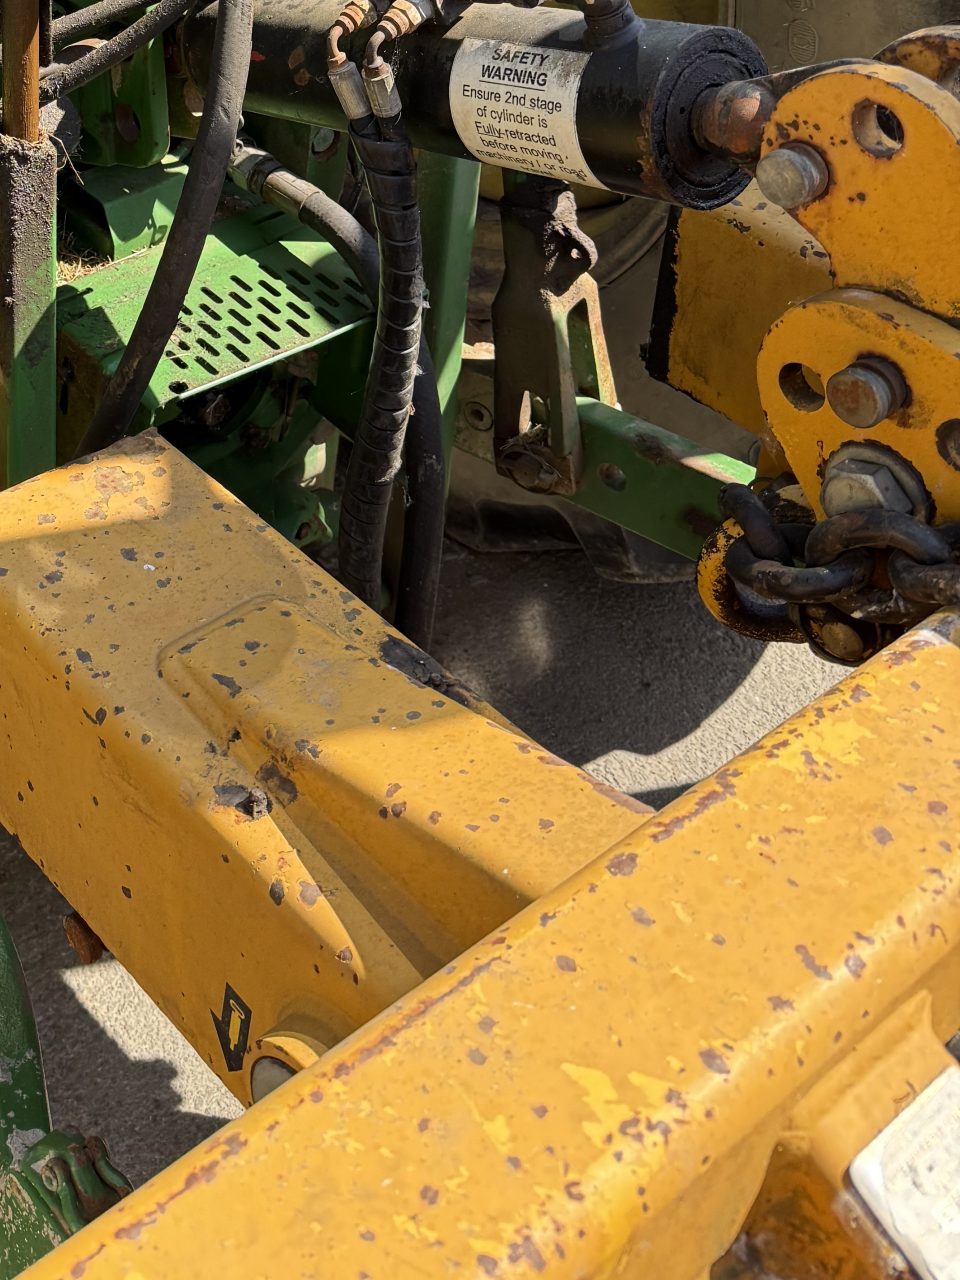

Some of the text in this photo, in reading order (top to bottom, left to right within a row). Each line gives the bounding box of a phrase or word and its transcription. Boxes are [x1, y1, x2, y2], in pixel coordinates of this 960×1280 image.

[492, 48, 550, 67] SAFETY
[481, 65, 548, 87] WARNING
[462, 84, 562, 114] Ensure 2nd stage
[476, 106, 548, 129] of cylinder is
[476, 149, 535, 168] machinery
[480, 137, 565, 164] before moving
